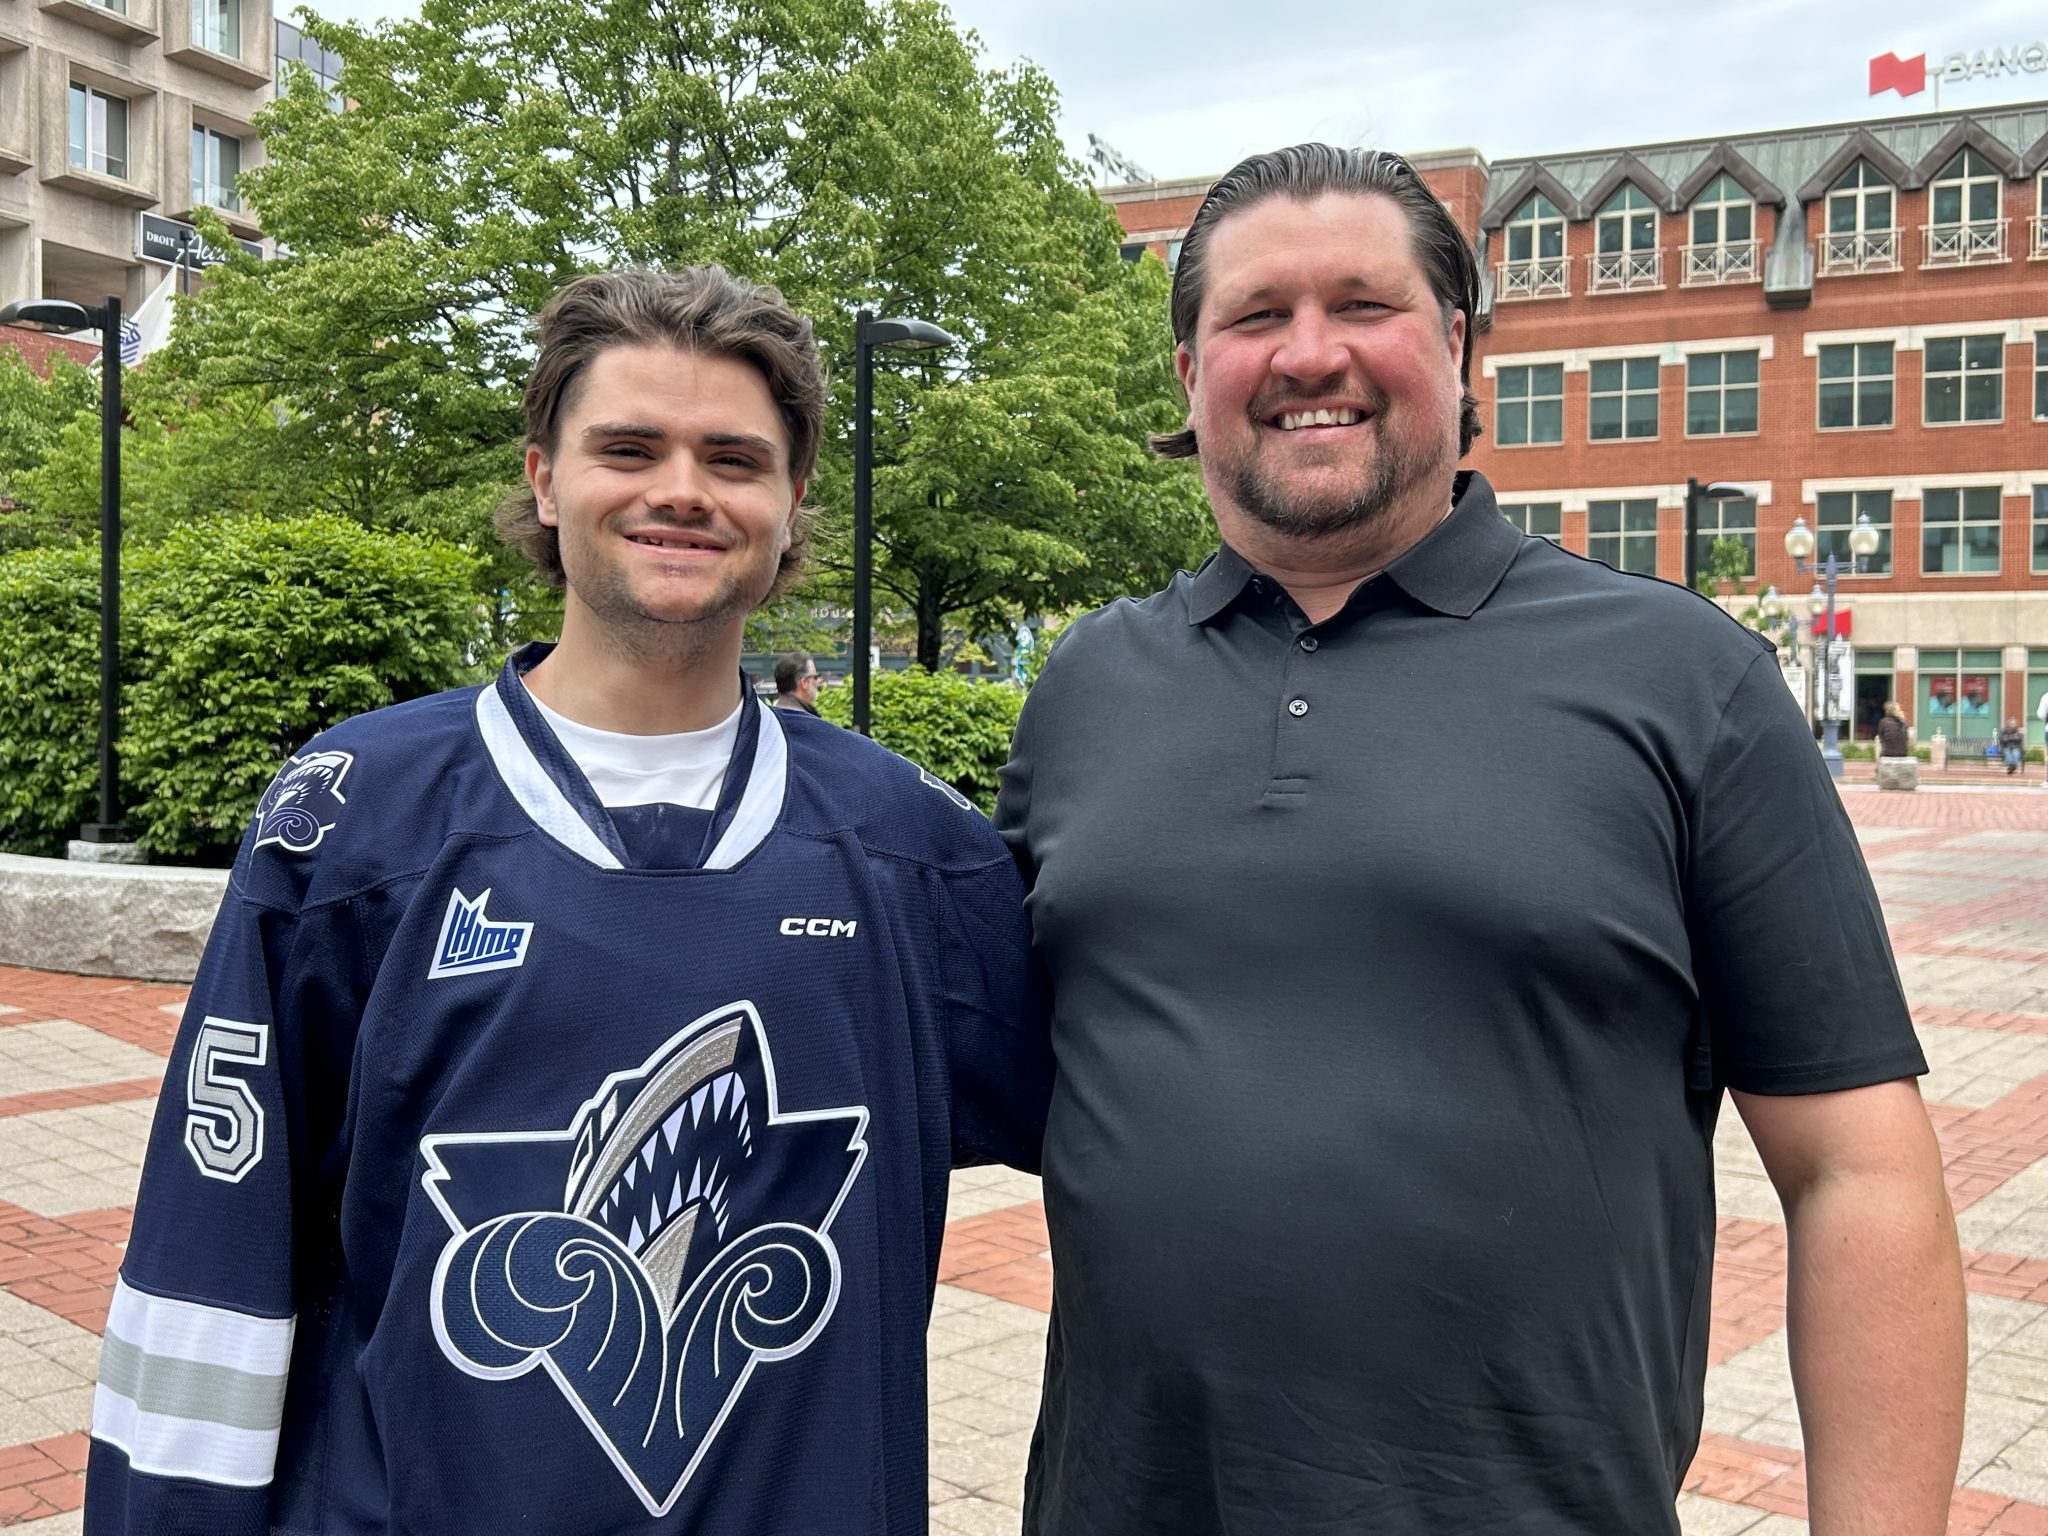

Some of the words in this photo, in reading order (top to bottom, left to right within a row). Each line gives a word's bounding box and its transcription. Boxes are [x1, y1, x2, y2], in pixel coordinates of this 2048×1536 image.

[146, 230, 176, 248] DROIT
[780, 918, 857, 937] CCM
[184, 1015, 269, 1184] 5
